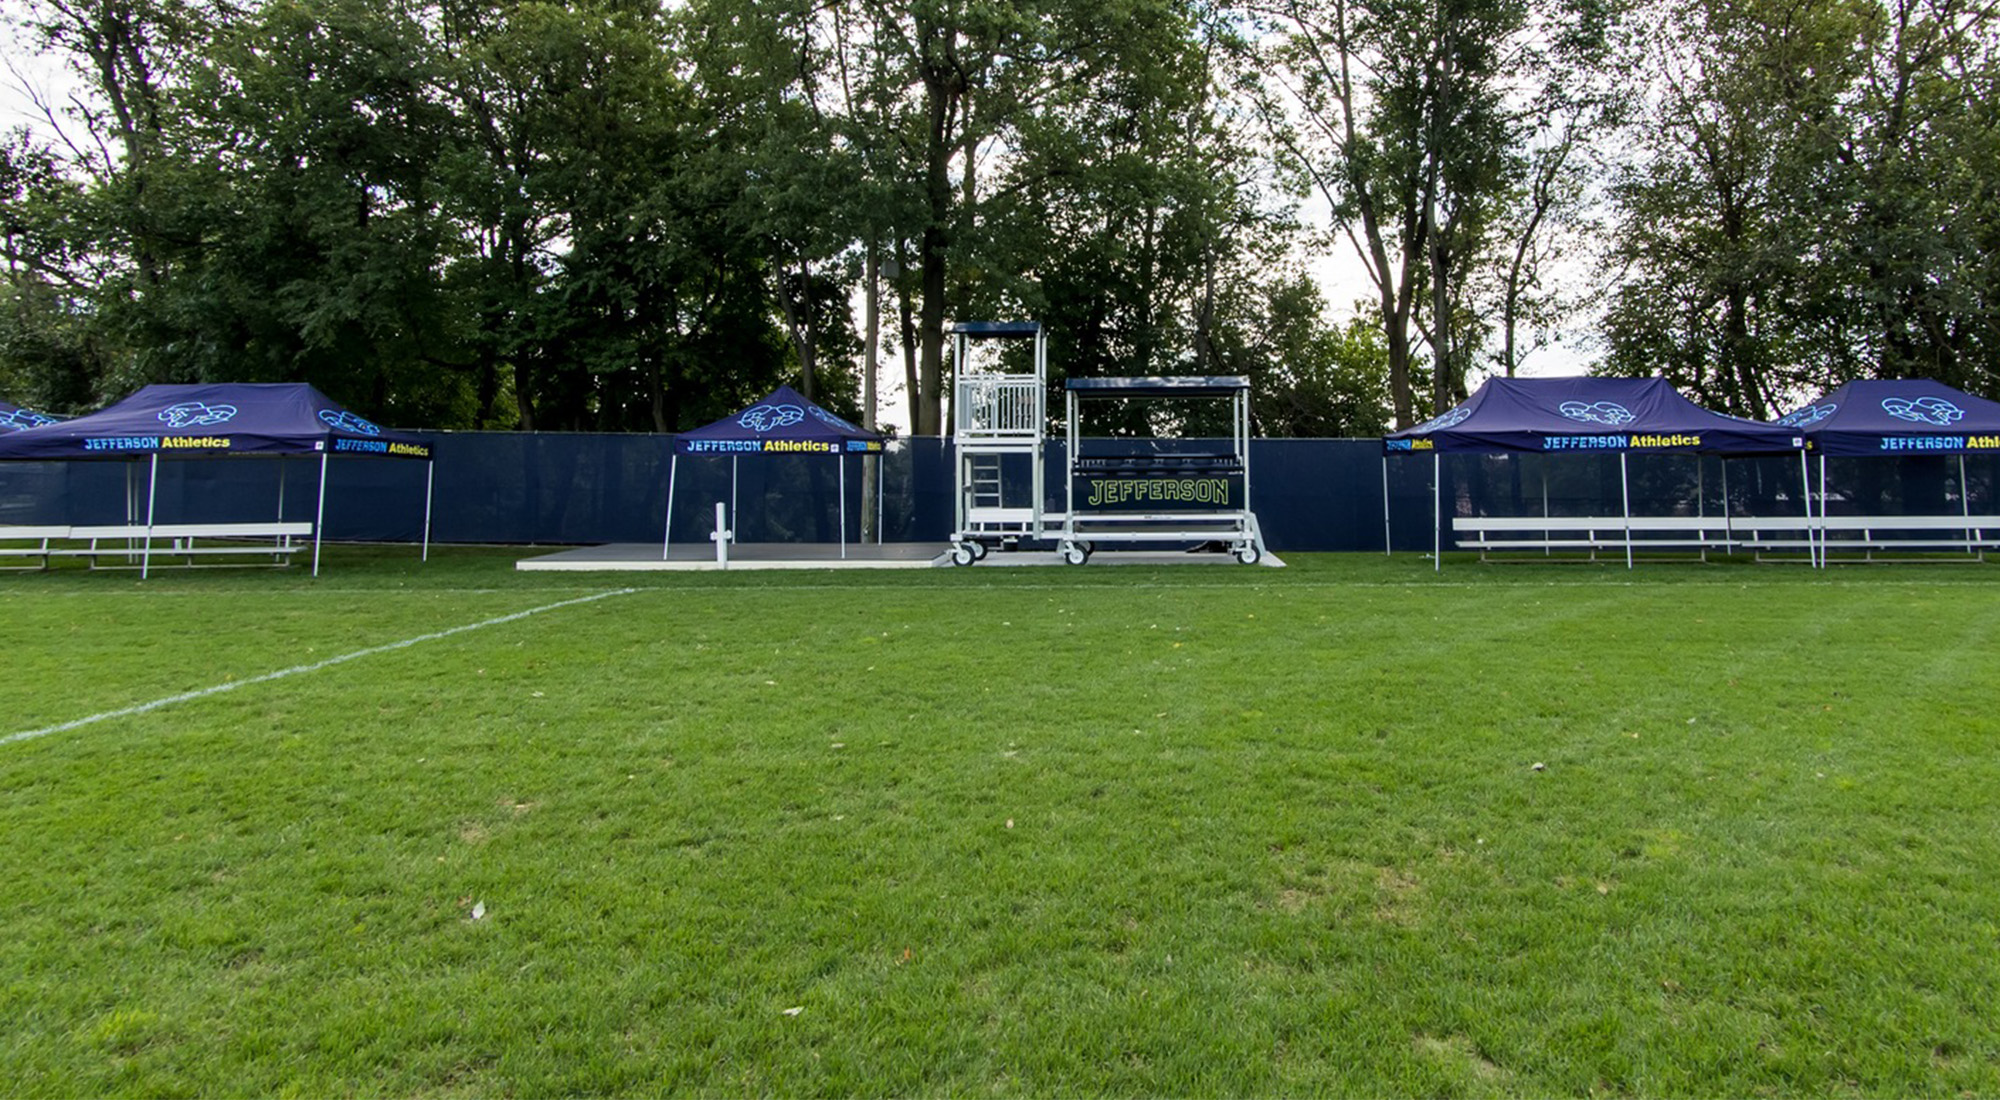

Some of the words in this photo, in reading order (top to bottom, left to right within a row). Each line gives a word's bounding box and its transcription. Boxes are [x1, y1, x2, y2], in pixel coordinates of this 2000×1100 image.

[85, 437, 158, 450] JEFFERSON
[162, 436, 230, 448] Athletics
[335, 439, 387, 453] JEFFERSON
[389, 442, 429, 456] Athletics
[687, 440, 761, 452] JEFFERSON
[764, 440, 829, 452] Athletics
[1543, 436, 1627, 449] JEFFERSON
[1630, 434, 1701, 447] Athletics
[1880, 436, 1963, 450] JEFFERSON
[1088, 479, 1229, 505] JEFFERSON
